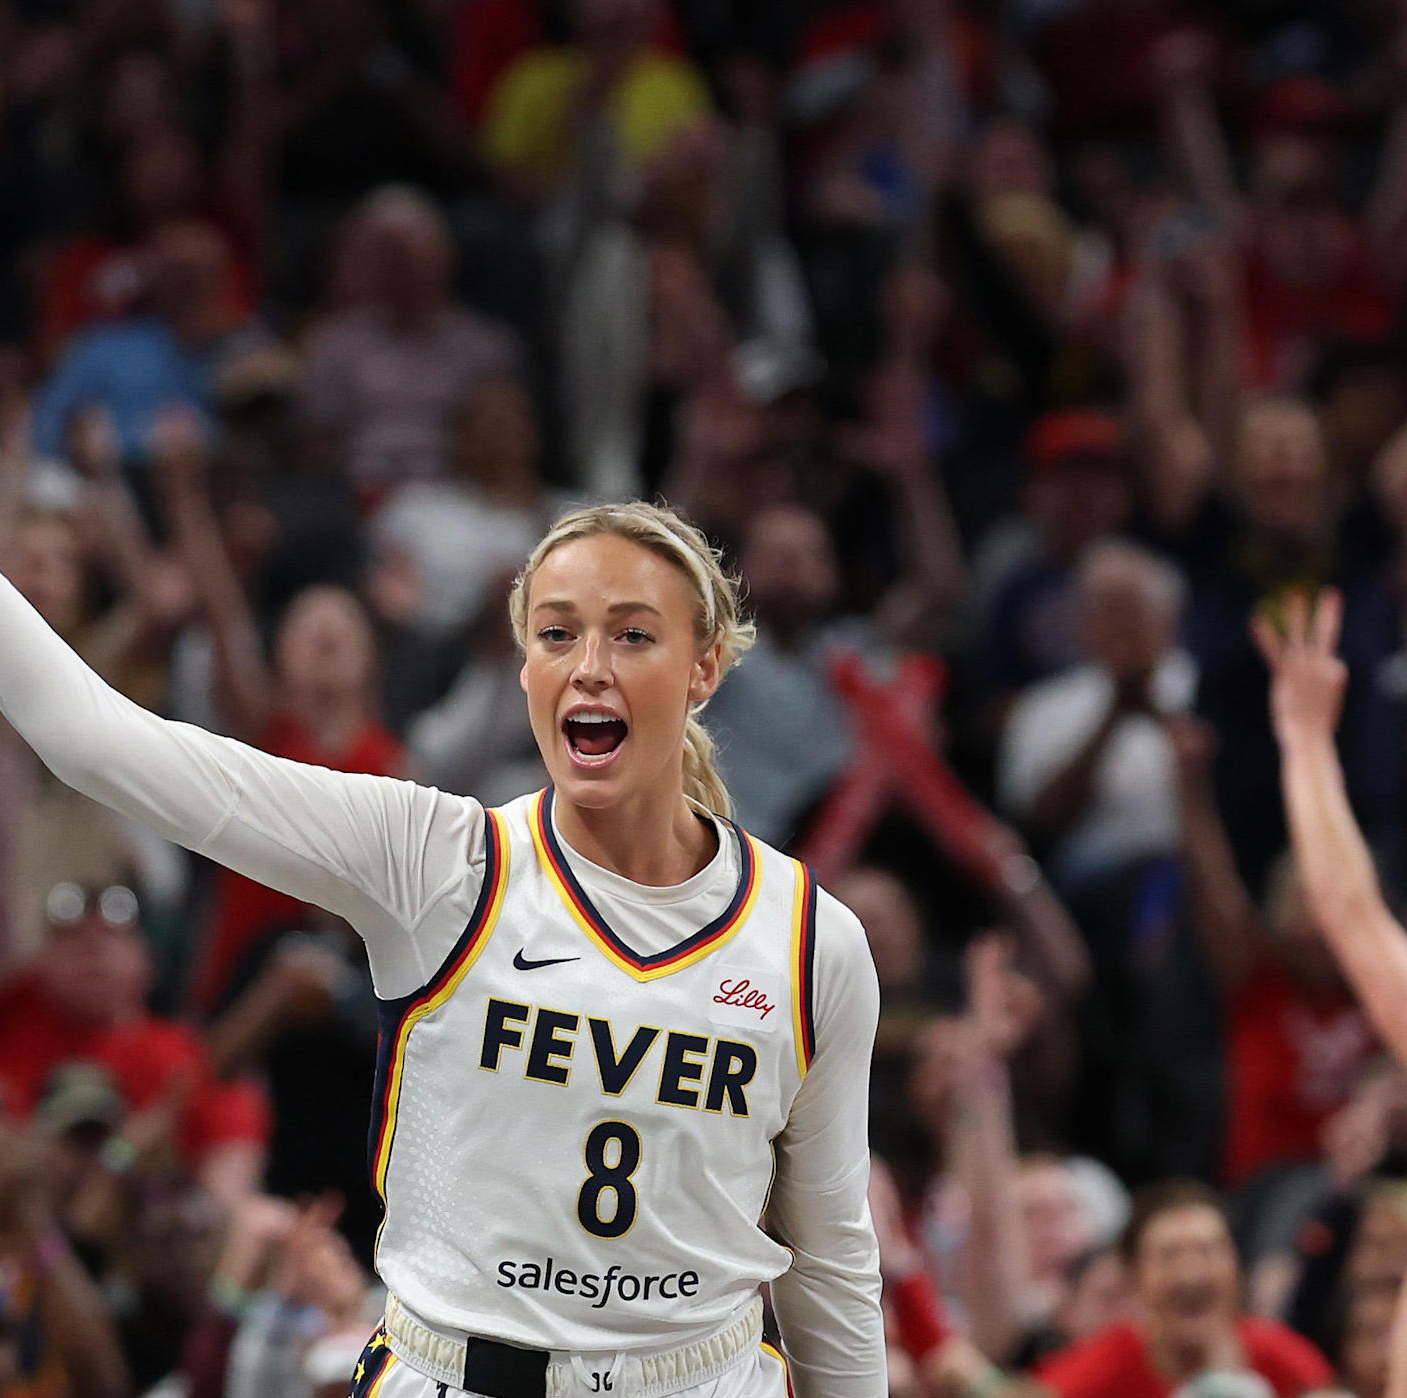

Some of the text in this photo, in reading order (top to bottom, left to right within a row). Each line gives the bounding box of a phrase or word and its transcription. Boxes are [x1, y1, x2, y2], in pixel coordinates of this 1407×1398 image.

[712, 978, 776, 1021] Lilly
[477, 996, 759, 1119] FEVER
[576, 1118, 643, 1241] 8
[496, 1257, 700, 1309] salesforce
